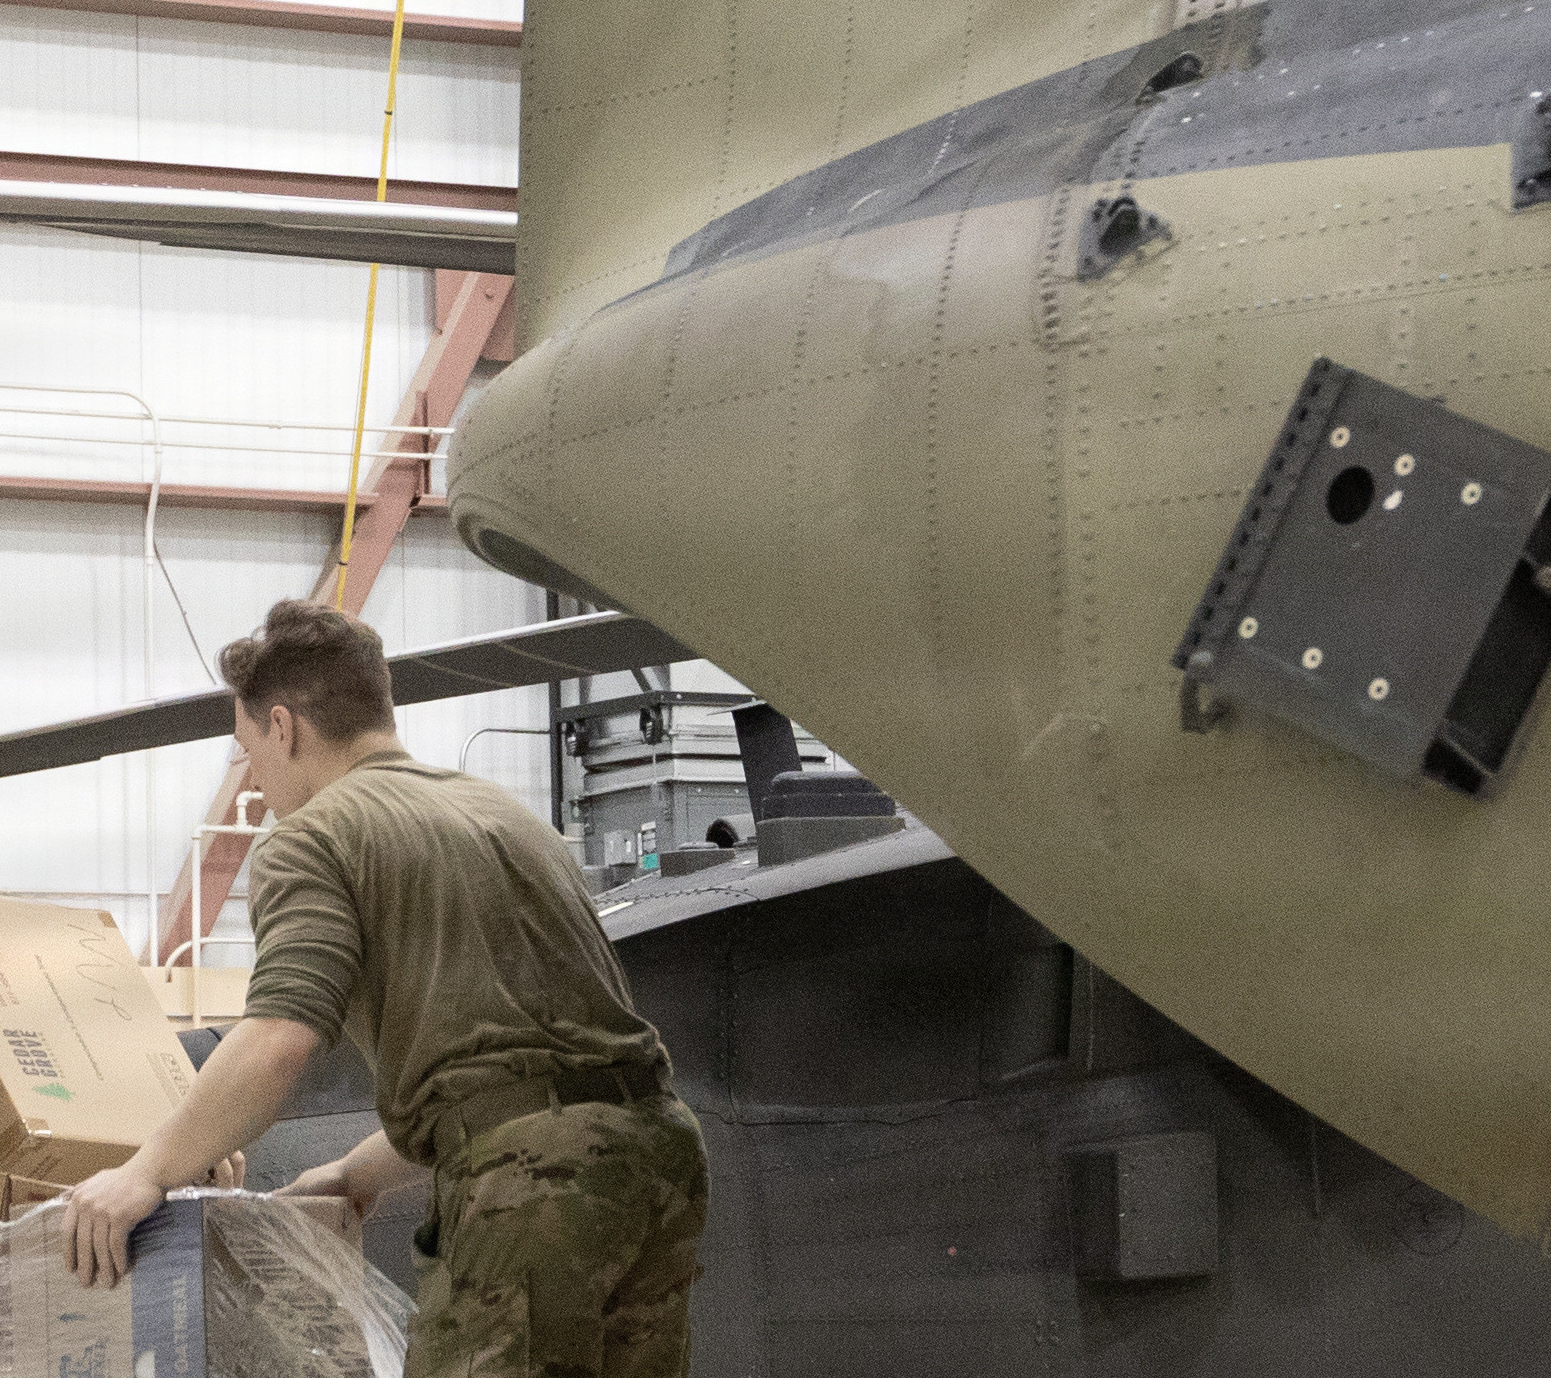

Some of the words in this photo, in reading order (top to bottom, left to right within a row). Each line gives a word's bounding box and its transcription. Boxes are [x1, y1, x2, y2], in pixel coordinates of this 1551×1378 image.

[2, 1028, 39, 1078] CEDAR
[20, 1030, 58, 1079] GROVE
[172, 1273, 189, 1374] OATMEAL
